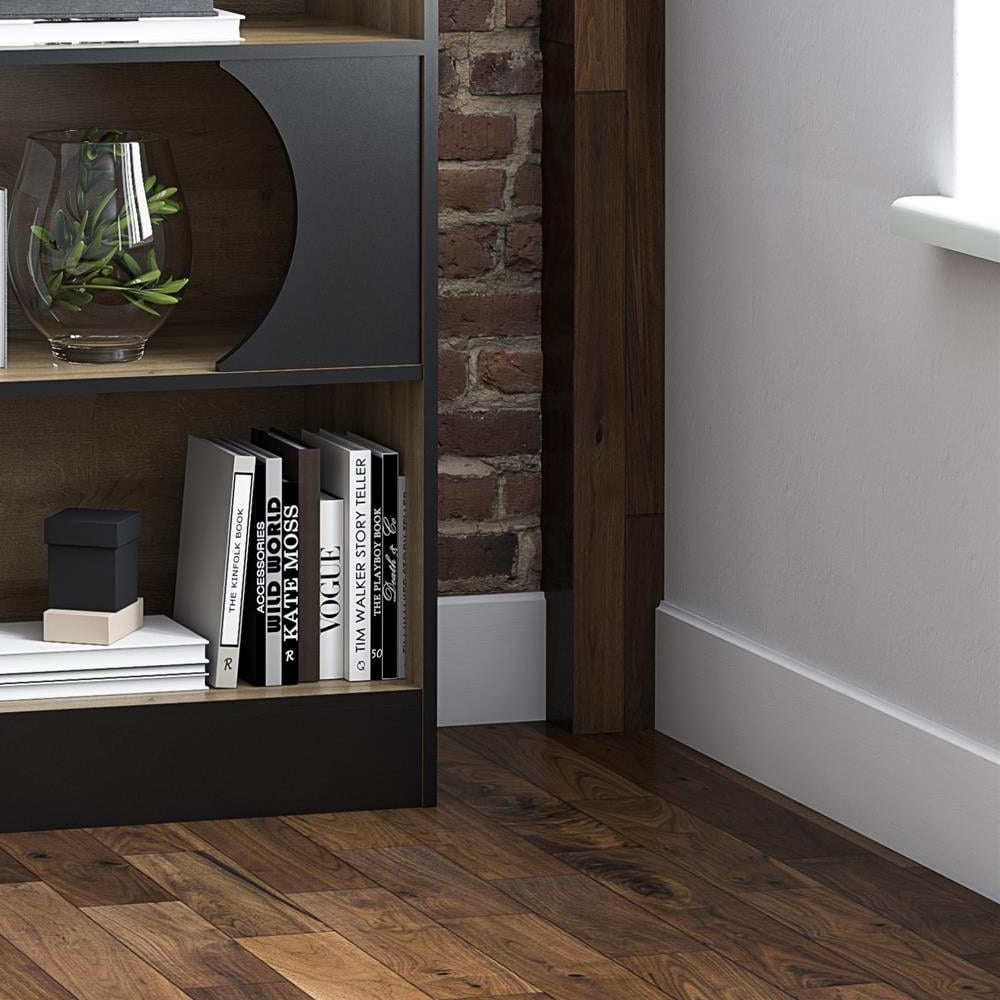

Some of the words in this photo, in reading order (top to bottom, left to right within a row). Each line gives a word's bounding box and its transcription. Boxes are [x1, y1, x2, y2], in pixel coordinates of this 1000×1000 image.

[355, 458, 366, 506] TELLER
[235, 508, 244, 539] BOOK
[267, 497, 280, 573] WORLD
[283, 504, 299, 571] MOSS
[355, 511, 366, 558] STORY
[373, 507, 381, 538] BOOK
[231, 542, 241, 588] KINFOLK
[256, 521, 265, 614] ACCESSORIES
[373, 541, 381, 592] PLAYBOY
[383, 554, 396, 602] Death
[229, 592, 237, 613] THE
[267, 581, 280, 632] WILD
[283, 577, 299, 642] KATE
[320, 546, 341, 633] VOGUE
[355, 563, 366, 623] WALKER
[373, 594, 381, 616] THE
[223, 657, 233, 671] R
[284, 649, 295, 662] R
[355, 628, 366, 653] TIM
